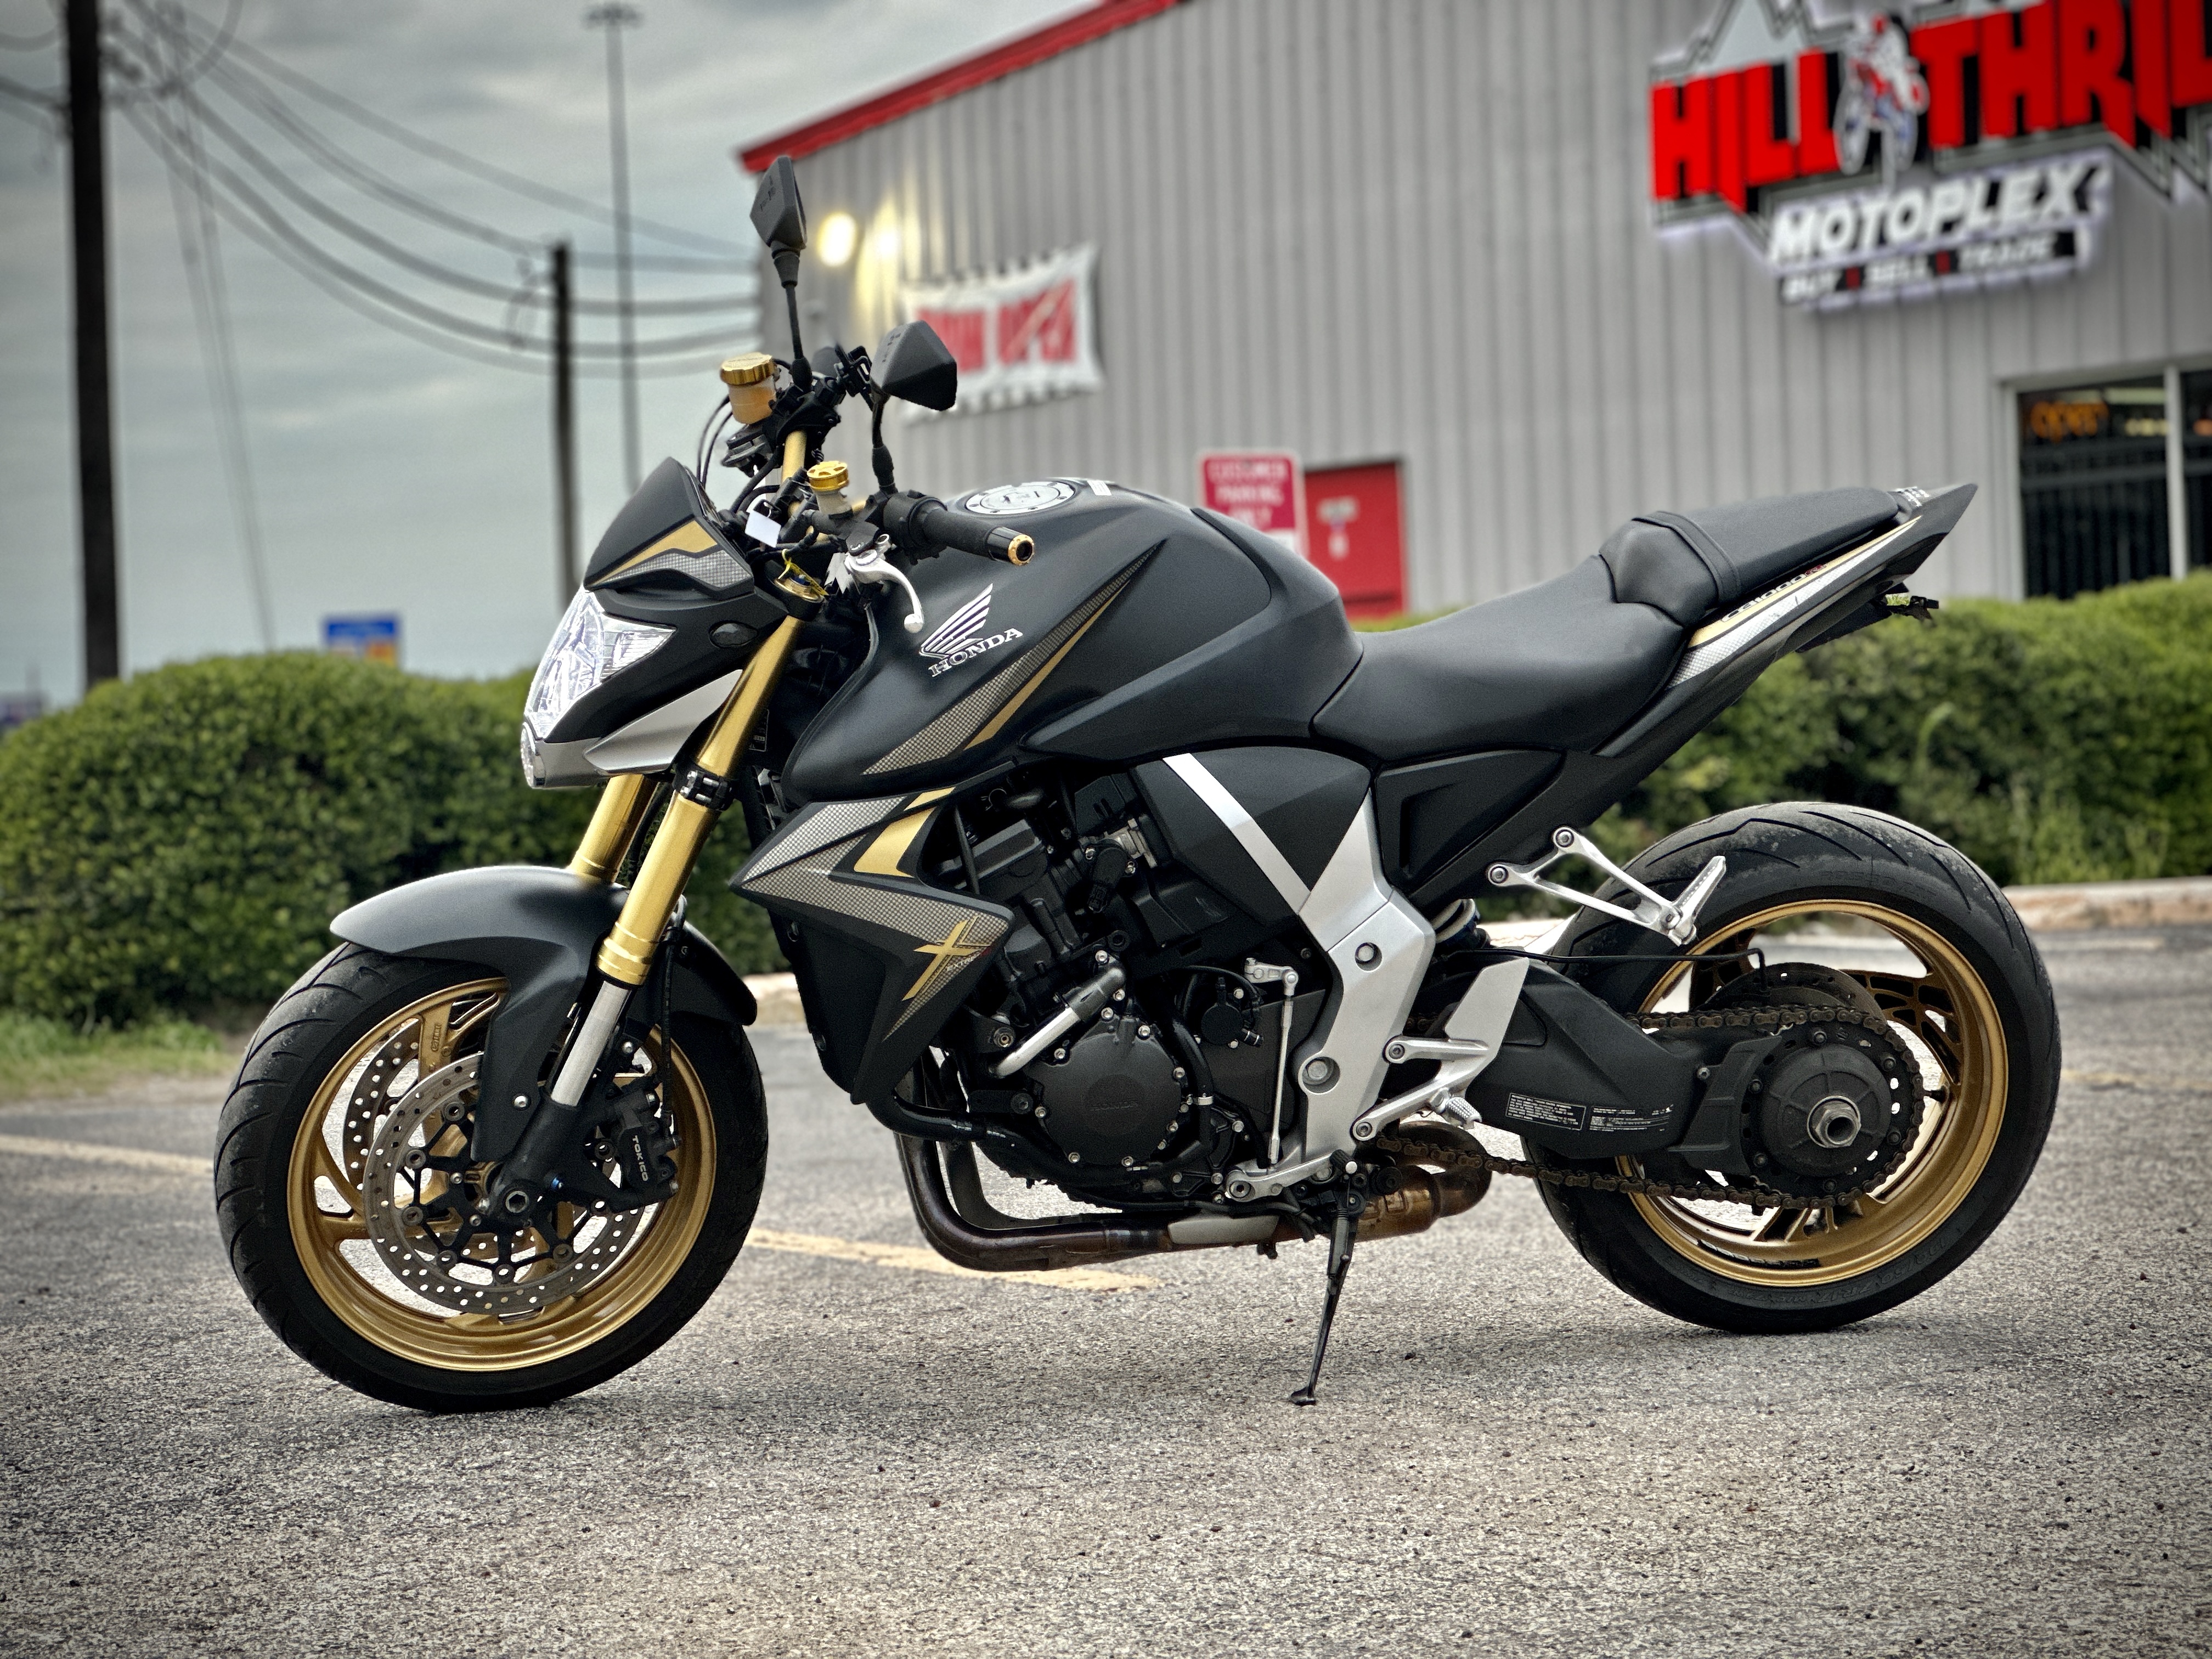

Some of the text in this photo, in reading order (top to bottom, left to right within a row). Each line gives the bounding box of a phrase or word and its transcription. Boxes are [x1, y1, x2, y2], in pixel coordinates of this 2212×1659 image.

[1651, 47, 1841, 214] HILL
[1768, 163, 2085, 262] MOTOPLEX
[928, 628, 1023, 677] HONDA
[632, 1135, 648, 1181] TOKICO
